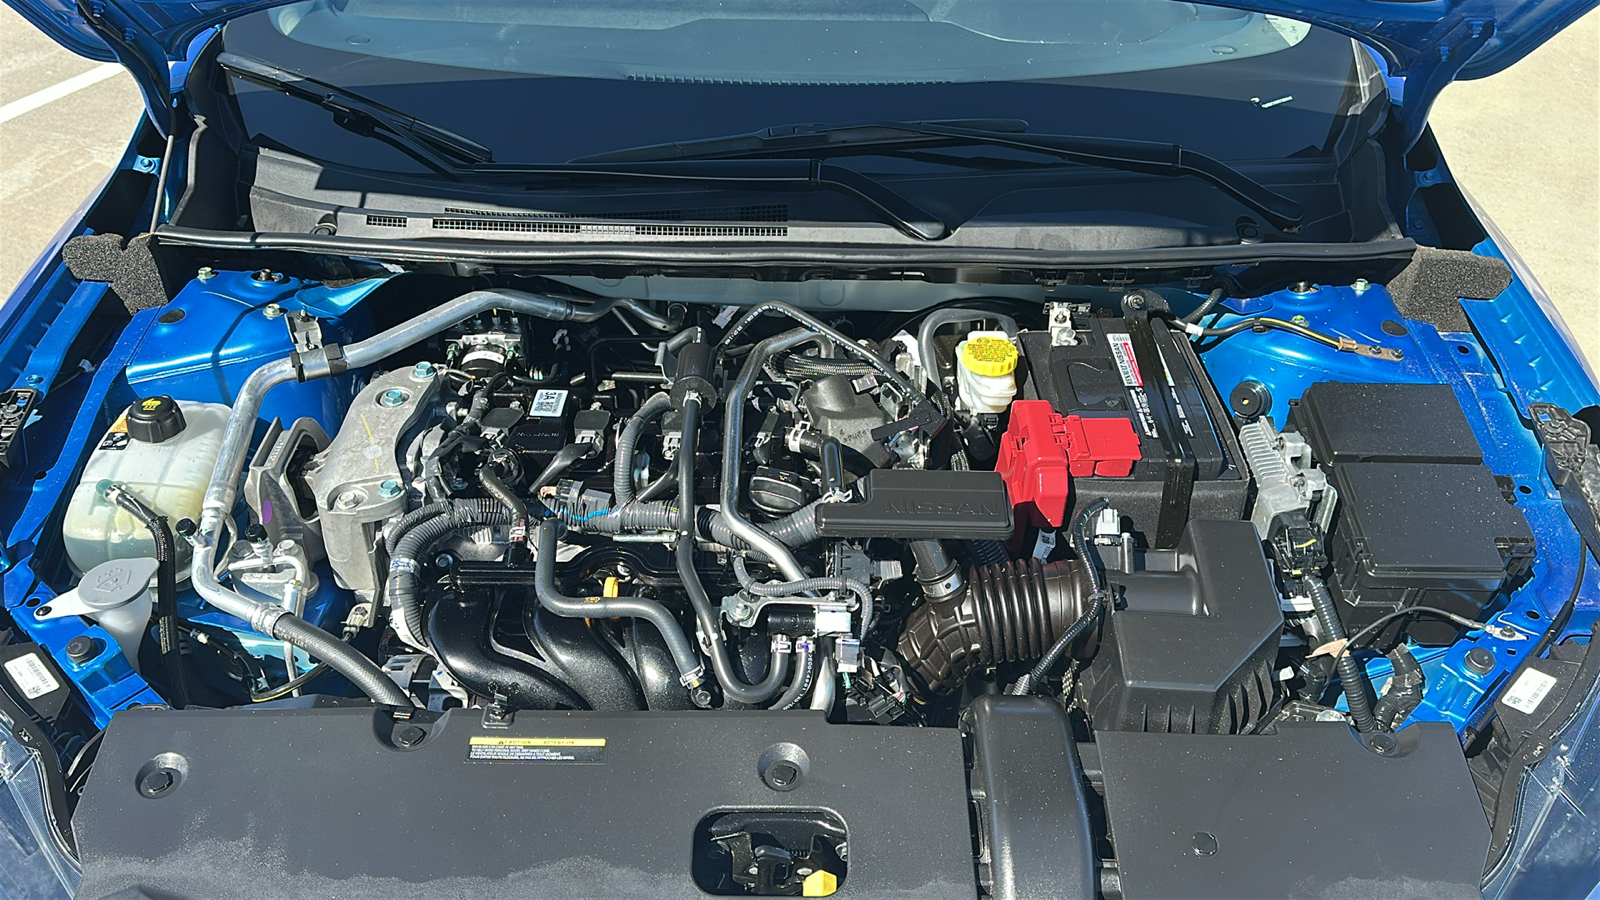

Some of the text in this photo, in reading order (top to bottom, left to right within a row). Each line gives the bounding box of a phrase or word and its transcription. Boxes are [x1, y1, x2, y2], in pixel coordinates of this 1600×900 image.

[1112, 342, 1126, 364] NISSAN
[543, 391, 557, 401] 3A
[885, 499, 1000, 516] NISSAN
